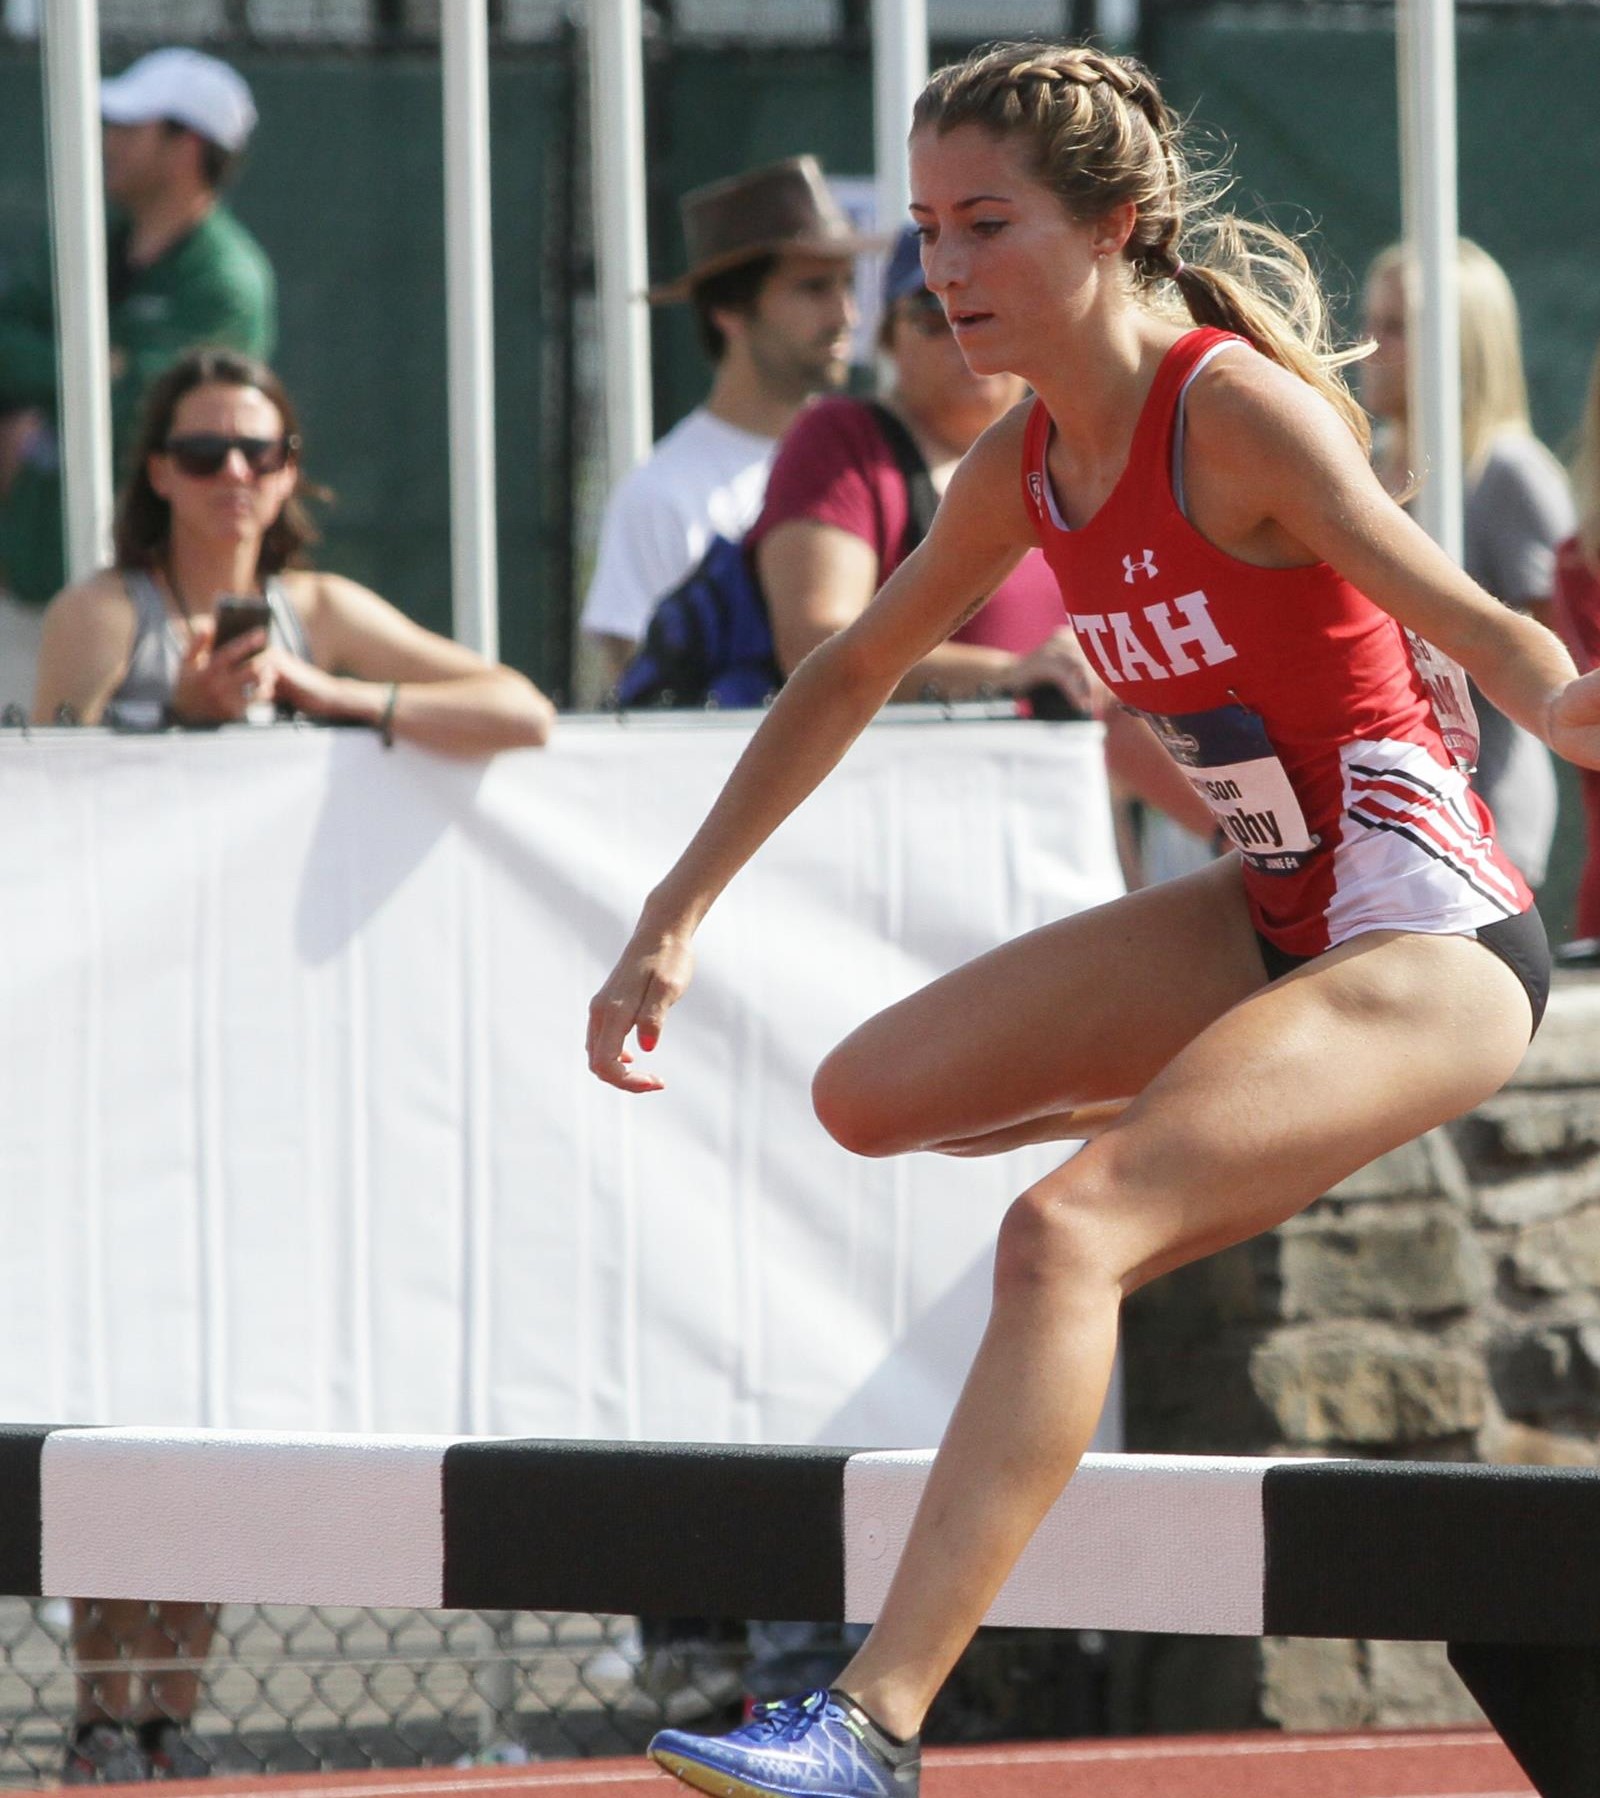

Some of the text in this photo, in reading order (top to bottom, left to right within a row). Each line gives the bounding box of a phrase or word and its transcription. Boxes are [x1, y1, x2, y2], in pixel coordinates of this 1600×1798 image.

[1067, 590, 1237, 683] TAH
[1201, 779, 1242, 800] son
[1223, 808, 1283, 848] phy
